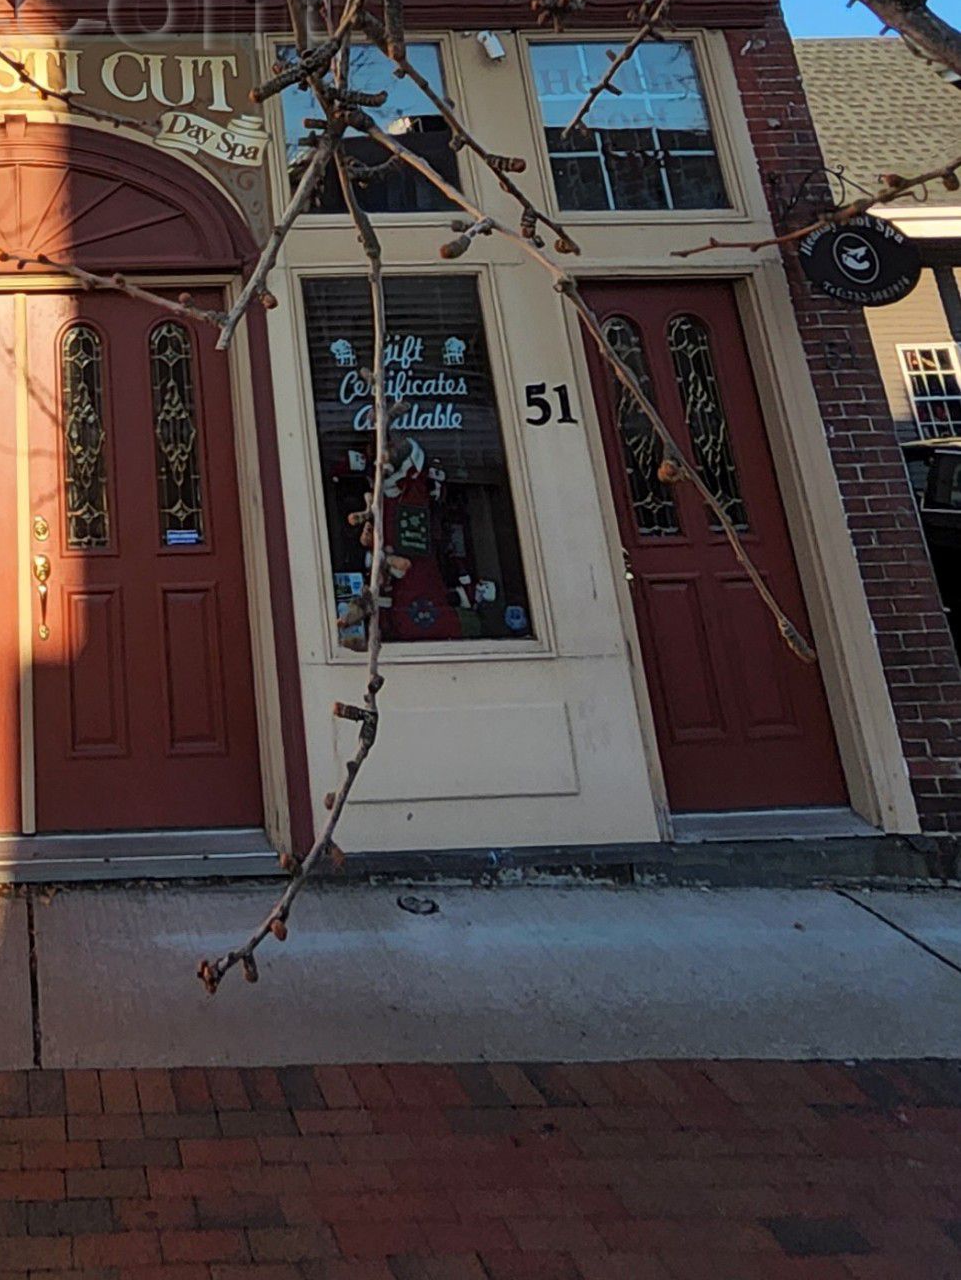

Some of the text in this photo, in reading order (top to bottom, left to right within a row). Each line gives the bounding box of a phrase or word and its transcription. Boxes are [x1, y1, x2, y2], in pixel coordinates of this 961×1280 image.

[101, 51, 238, 113] CUT
[165, 114, 259, 160] Day Spa
[876, 219, 904, 244] Spa
[384, 335, 424, 369] ift
[340, 371, 468, 404] Ceificates
[525, 382, 579, 426] 51
[353, 403, 463, 431] Ailable
